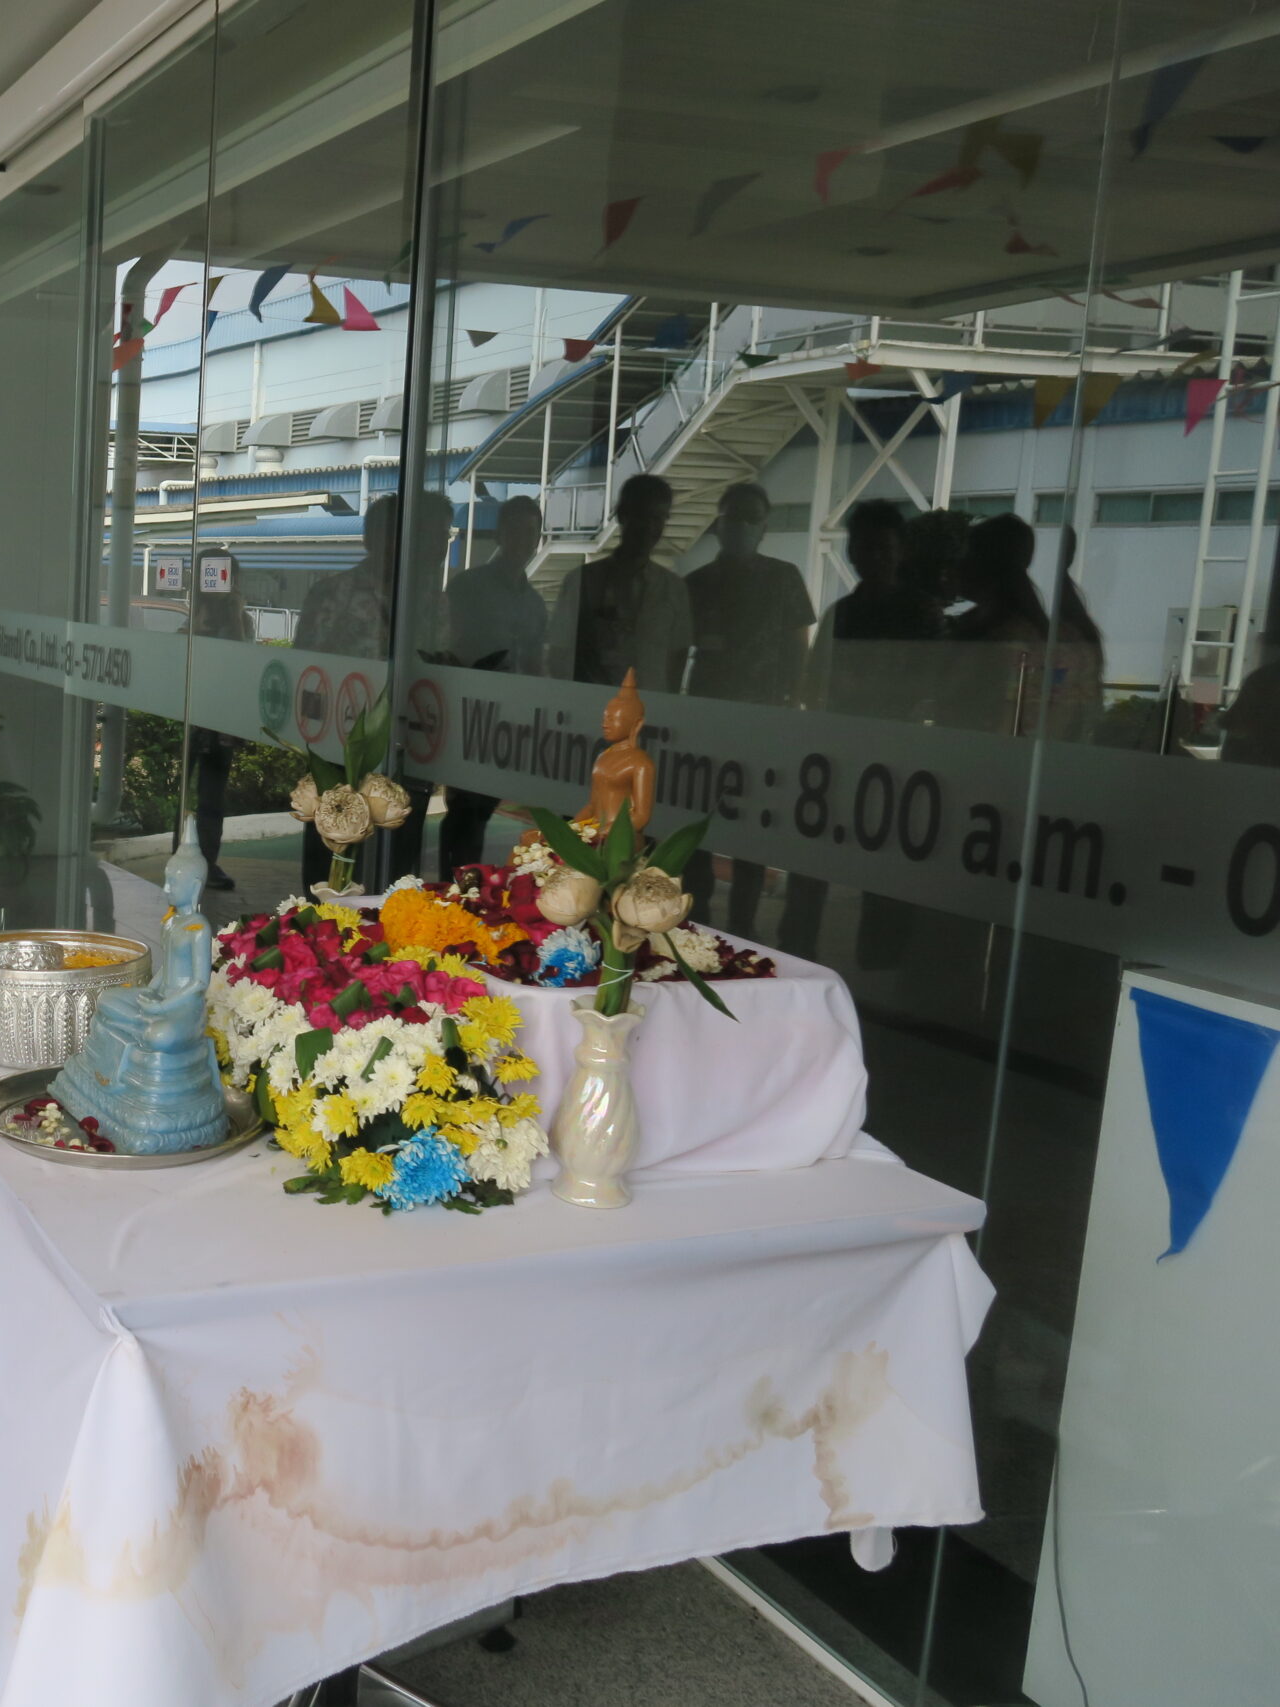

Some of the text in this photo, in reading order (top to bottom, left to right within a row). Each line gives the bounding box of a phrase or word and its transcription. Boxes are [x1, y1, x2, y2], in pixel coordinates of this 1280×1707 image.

[461, 697, 613, 788] Workin
[794, 752, 942, 862] 8.00
[961, 802, 1127, 906] a.m.
